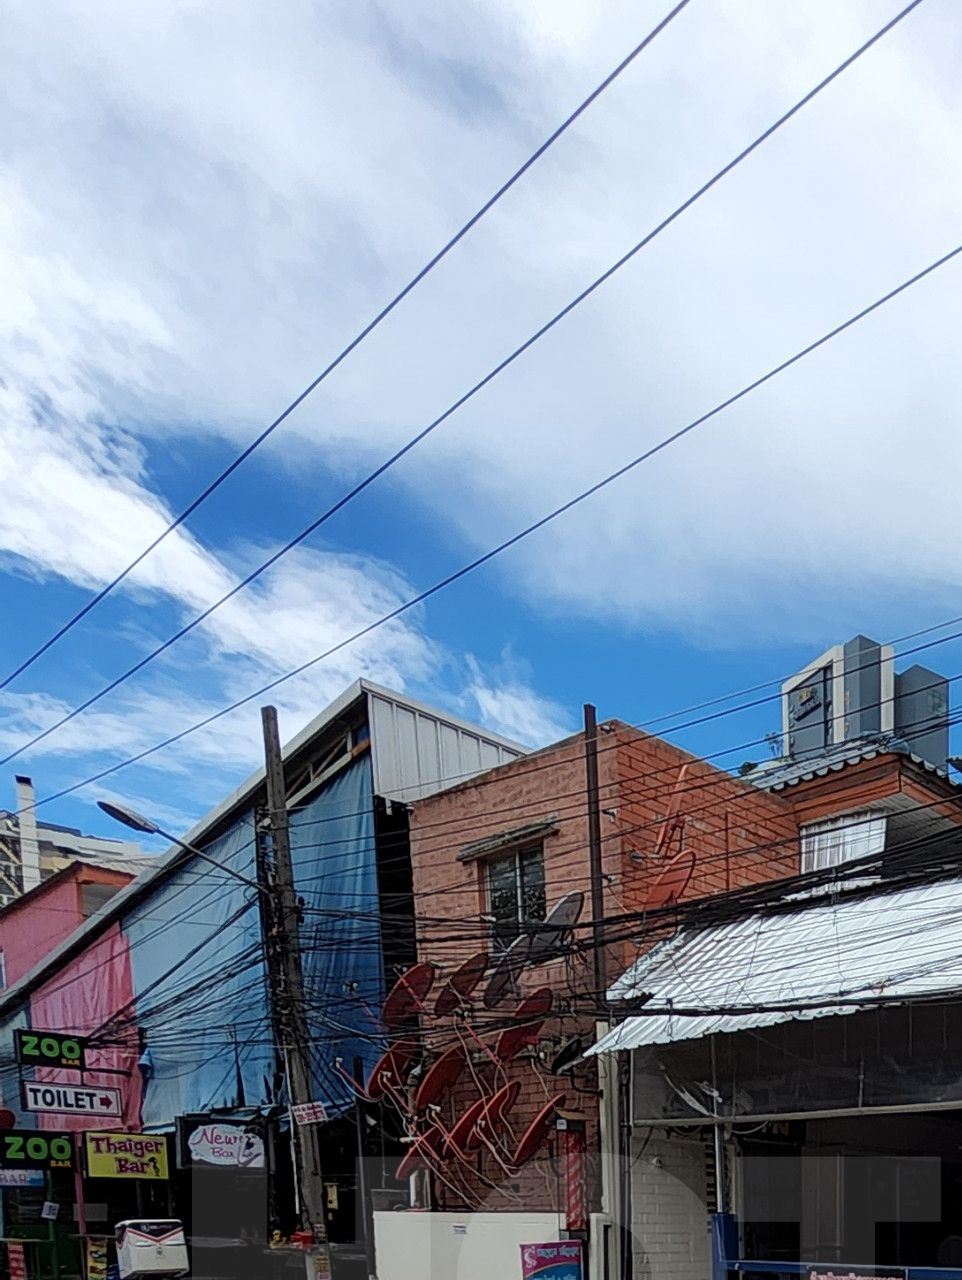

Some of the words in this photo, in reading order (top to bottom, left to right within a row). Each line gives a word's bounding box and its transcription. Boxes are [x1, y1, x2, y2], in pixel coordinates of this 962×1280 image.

[61, 1058, 81, 1066] BAR
[29, 1087, 97, 1110] TOILET
[89, 1136, 163, 1157] Thaiger
[50, 1159, 71, 1168] BAR
[115, 1157, 150, 1174] Bar
